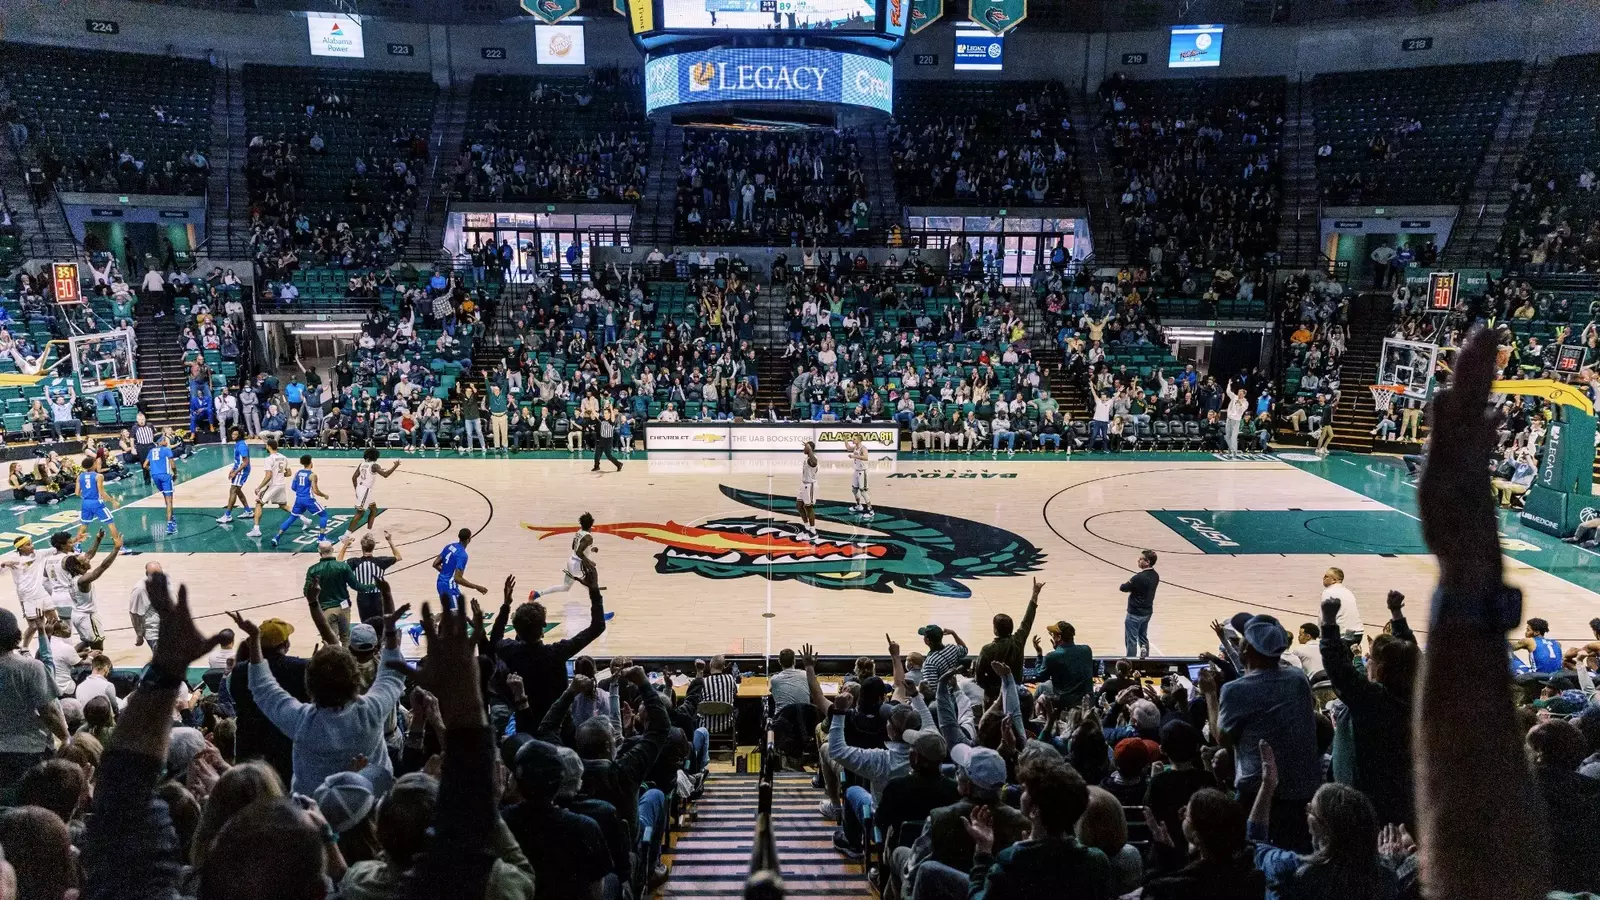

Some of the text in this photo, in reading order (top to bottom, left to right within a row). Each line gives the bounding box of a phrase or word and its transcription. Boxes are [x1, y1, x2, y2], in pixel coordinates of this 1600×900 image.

[779, 2, 791, 10] 89
[91, 22, 113, 32] 224
[322, 37, 352, 45] Alabama
[1408, 40, 1426, 49] 218
[392, 45, 409, 54] 223
[486, 49, 502, 58] 222
[919, 55, 934, 65] 220
[1127, 55, 1143, 63] 219
[718, 62, 829, 91] LEGACY
[58, 279, 74, 298] 30
[1434, 288, 1449, 306] 30
[879, 431, 893, 441] 811
[152, 448, 159, 460] 12
[1543, 439, 1559, 486] LEGACY
[85, 479, 91, 489] 3
[299, 476, 306, 486] 11
[445, 551, 452, 564] 4
[1542, 639, 1556, 659] 1
